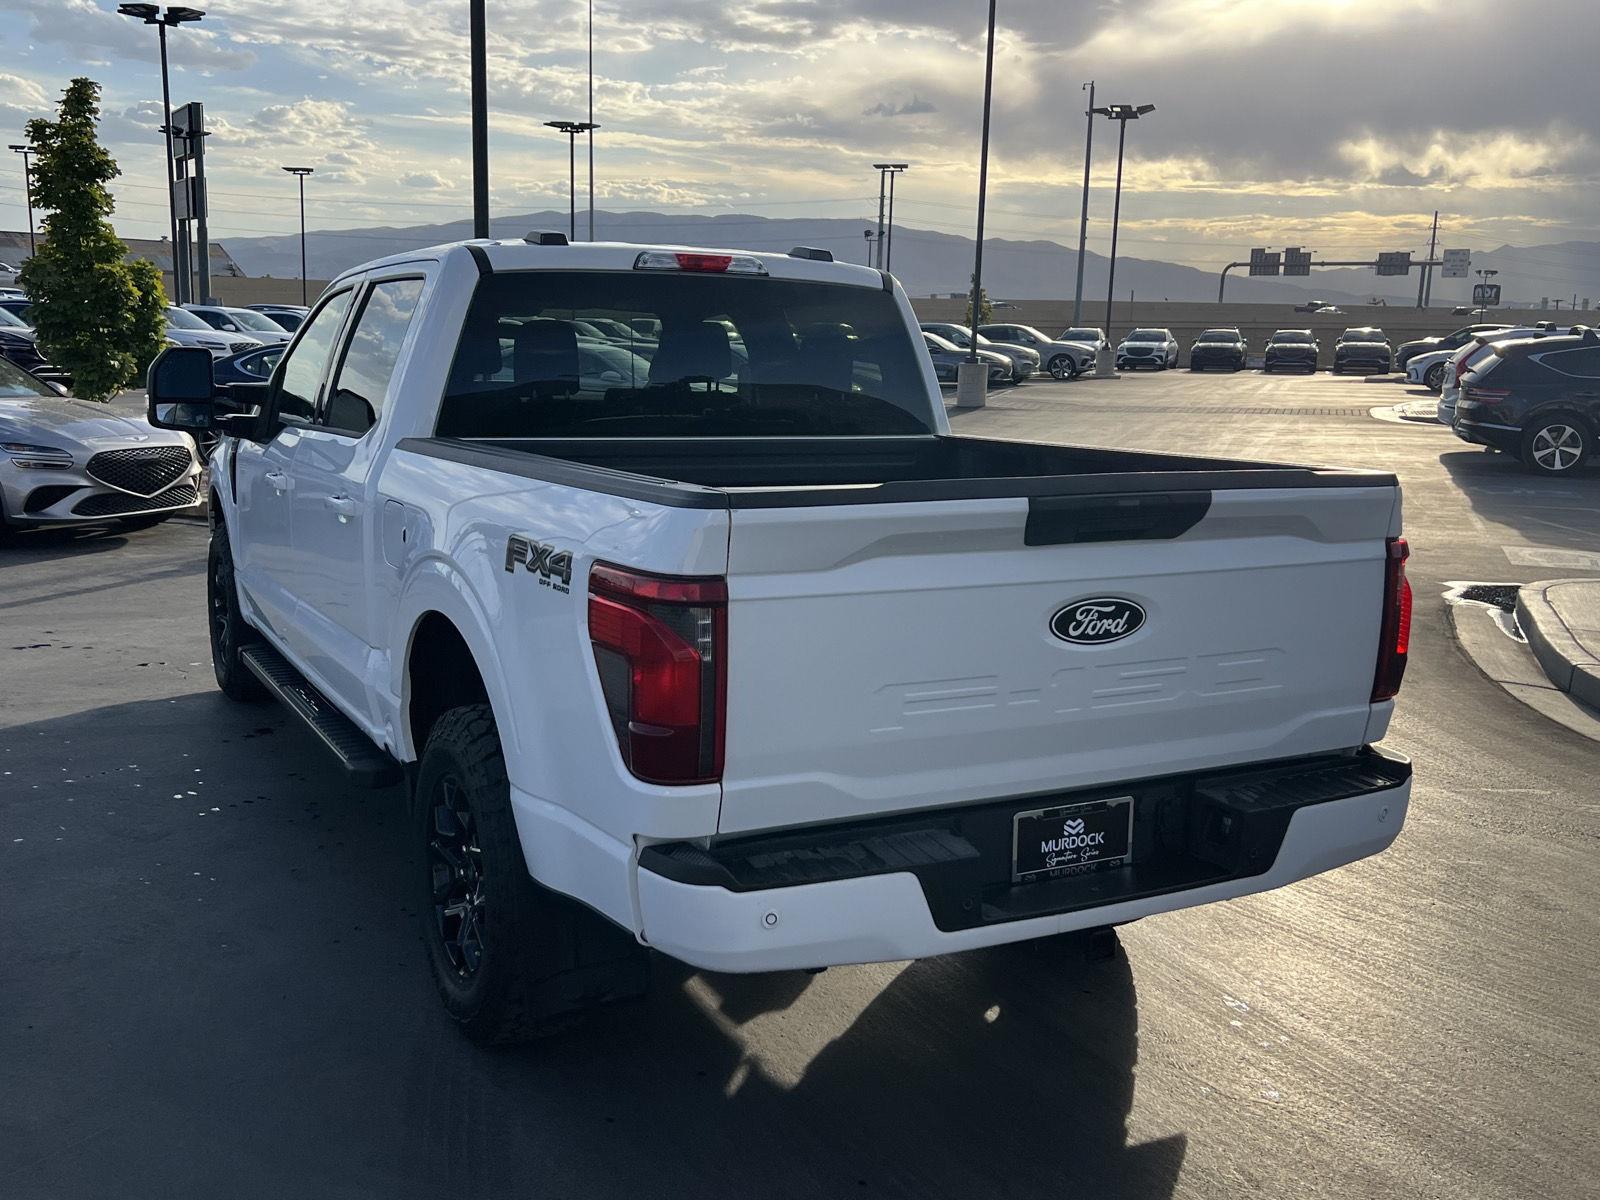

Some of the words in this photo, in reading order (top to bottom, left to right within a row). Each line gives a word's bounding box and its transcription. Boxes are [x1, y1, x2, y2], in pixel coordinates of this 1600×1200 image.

[505, 534, 573, 585] FX4
[539, 578, 551, 588] OFF
[552, 583, 570, 594] ROAD
[1068, 605, 1130, 637] Ford
[1041, 832, 1105, 853] MURDOCK
[1046, 850, 1077, 868] Signature
[1080, 847, 1100, 862] Series
[1049, 863, 1098, 877] MURDOCK
